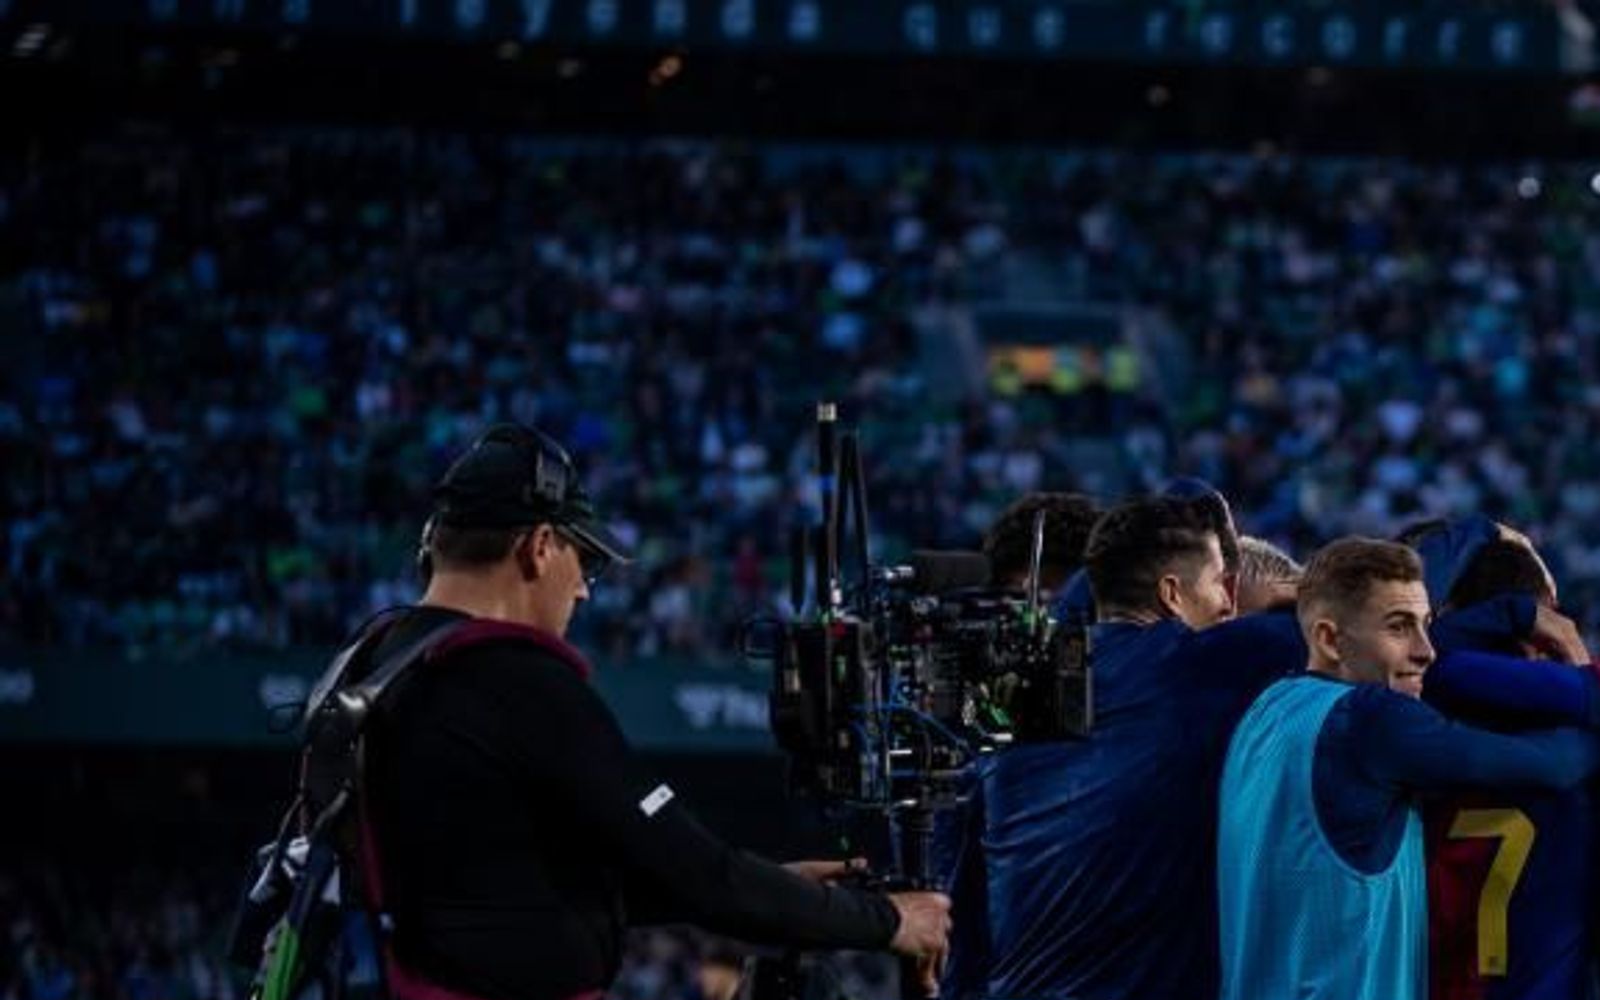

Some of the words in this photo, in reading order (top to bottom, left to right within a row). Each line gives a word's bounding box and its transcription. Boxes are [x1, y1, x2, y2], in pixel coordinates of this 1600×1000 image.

[903, 3, 1065, 53] que
[1145, 10, 1522, 66] recorre
[1446, 807, 1537, 977] 7
